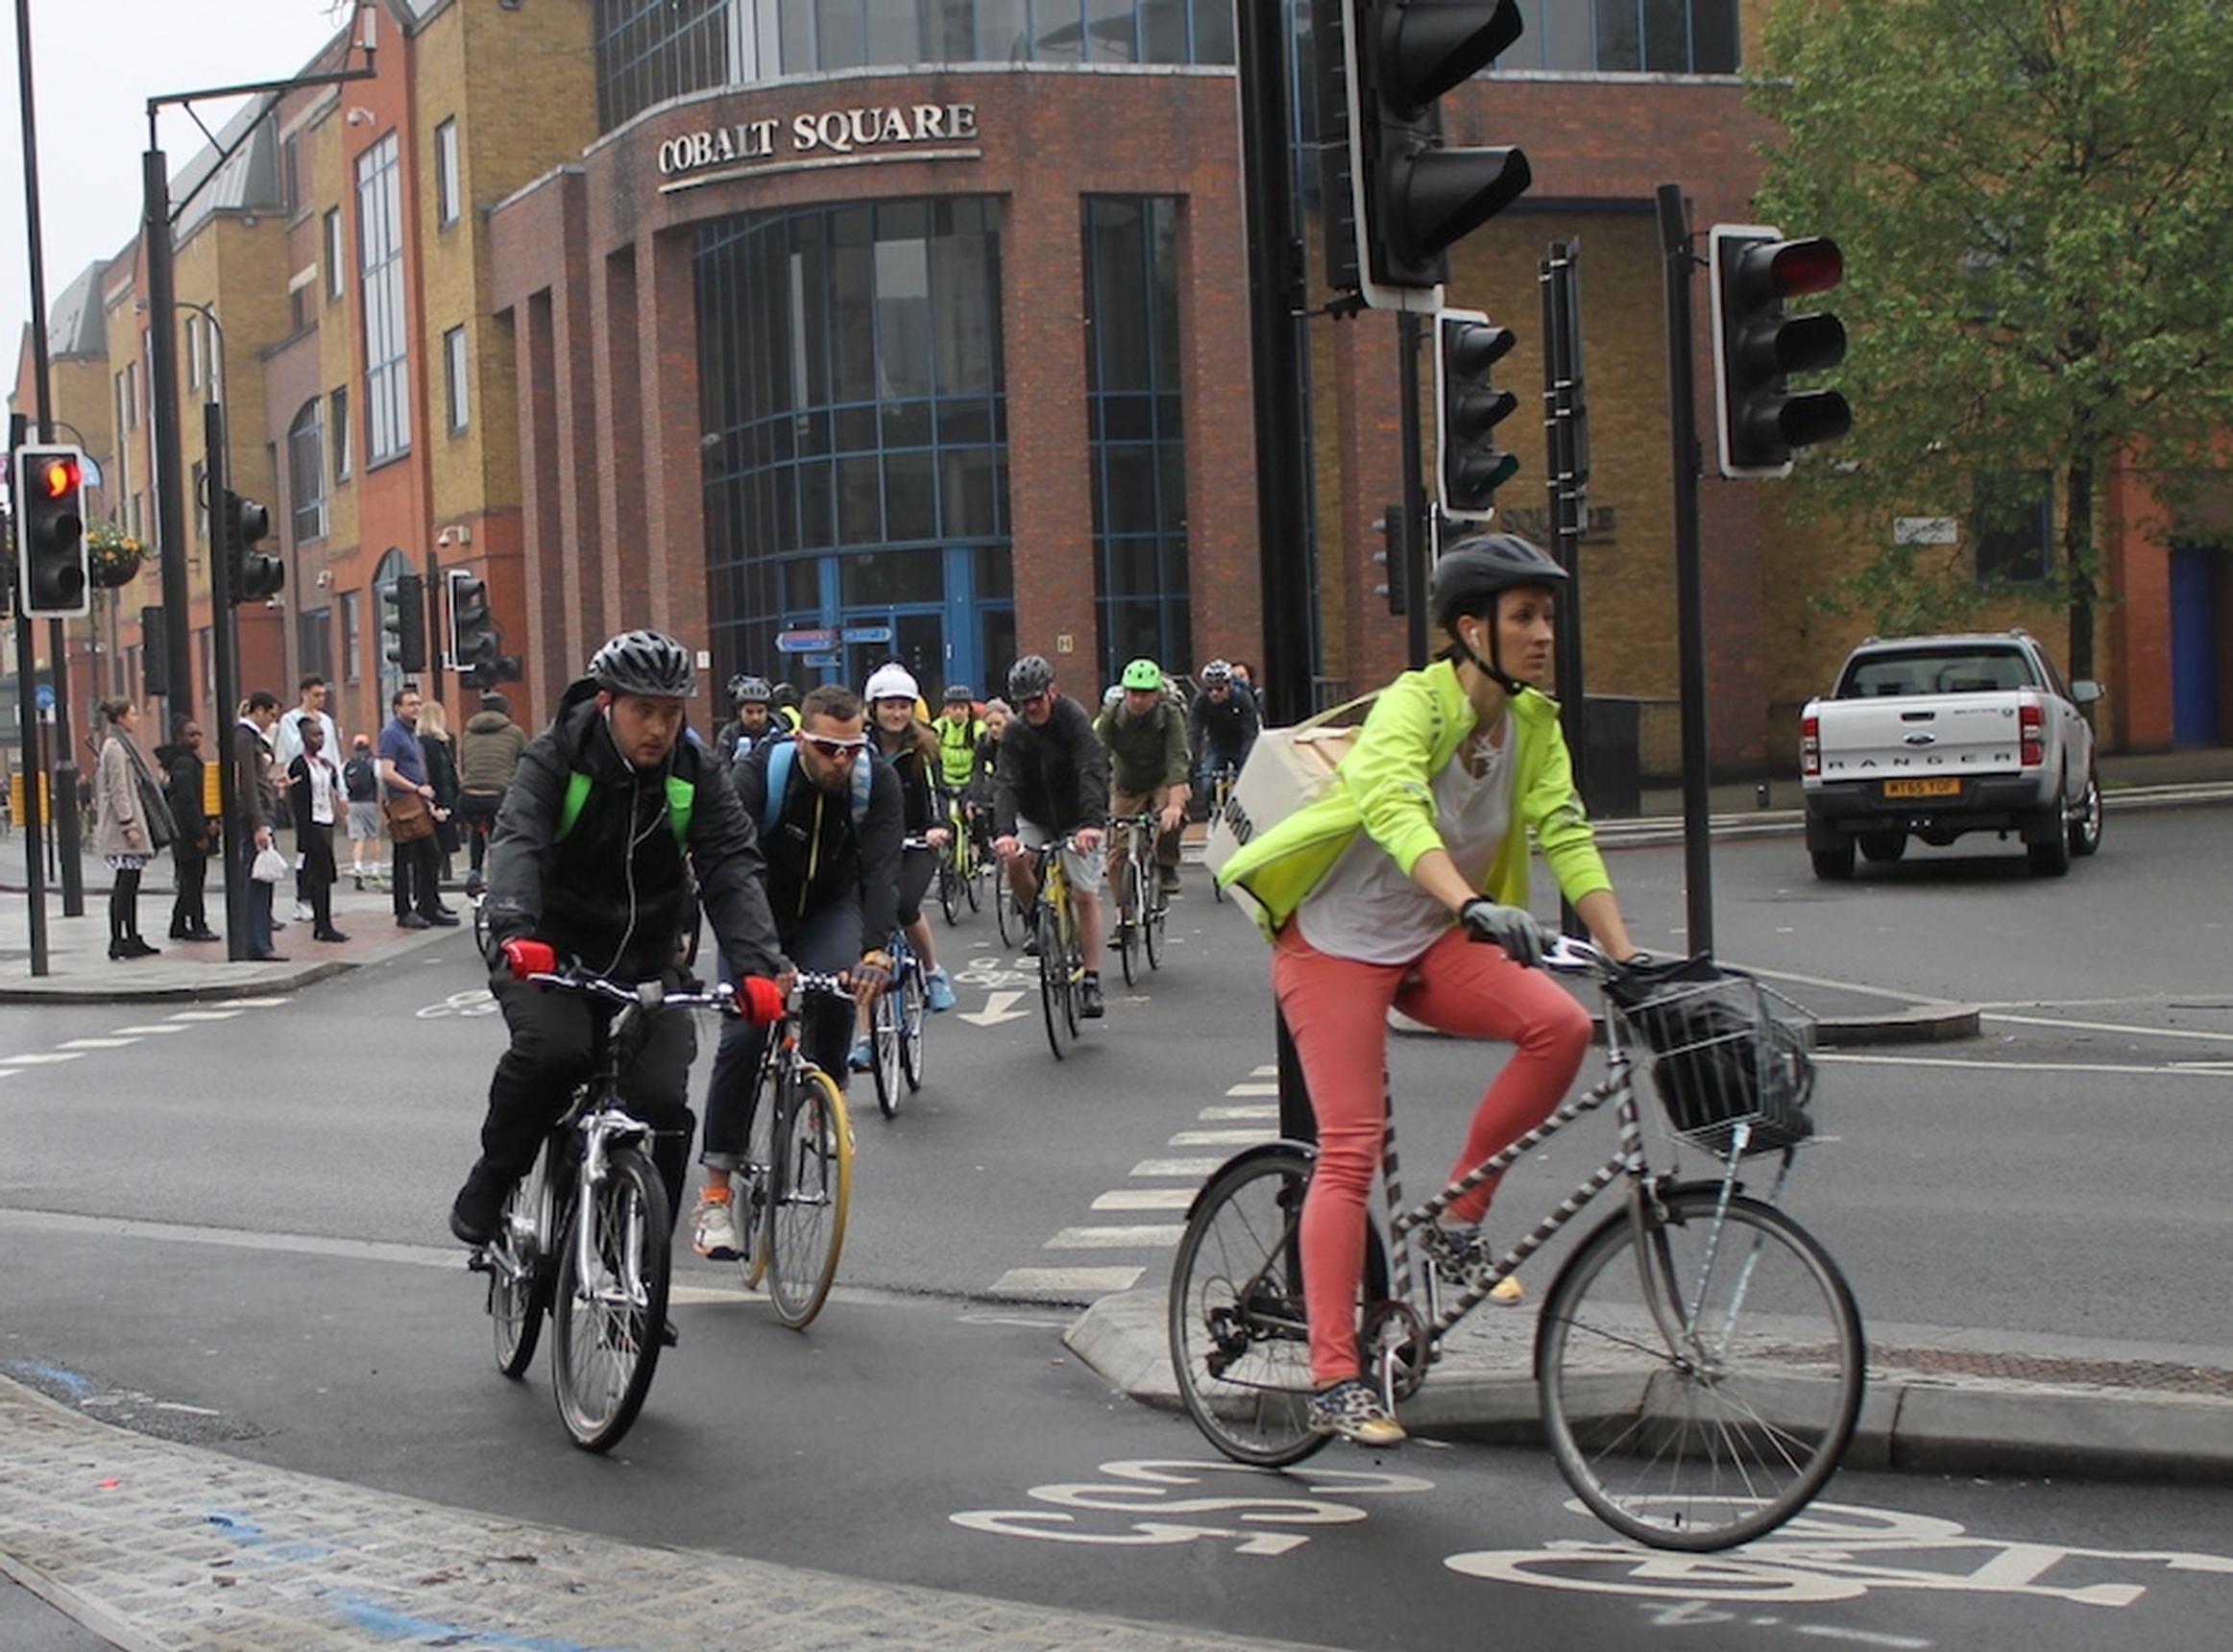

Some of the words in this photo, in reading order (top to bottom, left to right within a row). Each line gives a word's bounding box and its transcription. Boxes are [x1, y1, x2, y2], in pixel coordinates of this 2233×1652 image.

[658, 118, 780, 175] COBALT
[792, 103, 980, 153] SQUARE
[1059, 638, 1071, 650] H
[1828, 752, 2012, 770] RANGER
